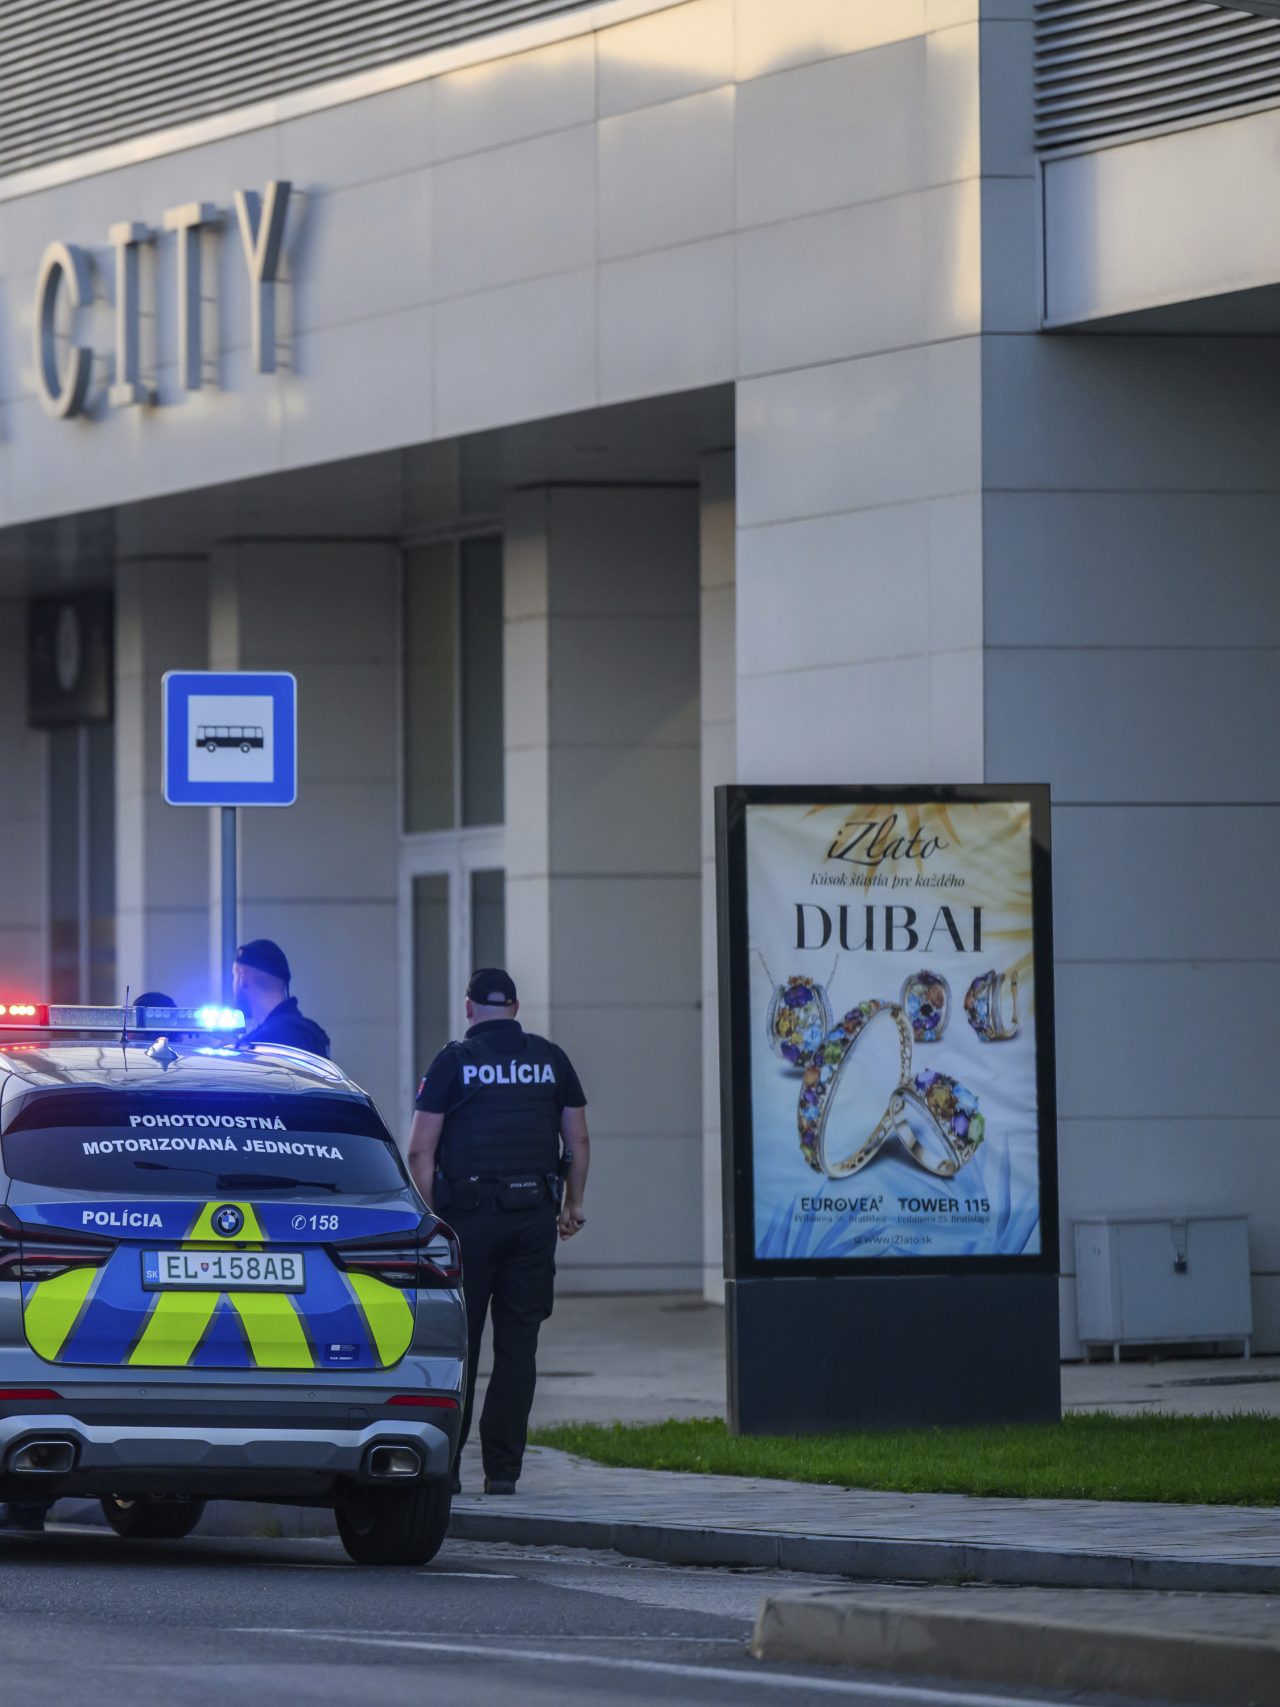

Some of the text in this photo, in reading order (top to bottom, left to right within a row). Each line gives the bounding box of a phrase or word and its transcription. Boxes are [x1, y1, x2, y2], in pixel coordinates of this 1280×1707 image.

[34, 180, 293, 420] CITY
[827, 814, 950, 867] iZlato
[810, 872, 848, 887] Kúsok
[891, 874, 913, 889] pre
[915, 873, 966, 888] každého
[793, 902, 985, 953] DUBAI
[462, 1059, 557, 1085] POLÍCIA
[129, 1114, 287, 1131] POHOTOVOSTNÁ
[82, 1136, 344, 1160] MOTORIZOVANÁ JEDNOTKA
[897, 1197, 991, 1213] TOWER 115
[82, 1209, 163, 1228] POLÍCIA
[309, 1214, 339, 1231] 158
[146, 1270, 158, 1279] SK
